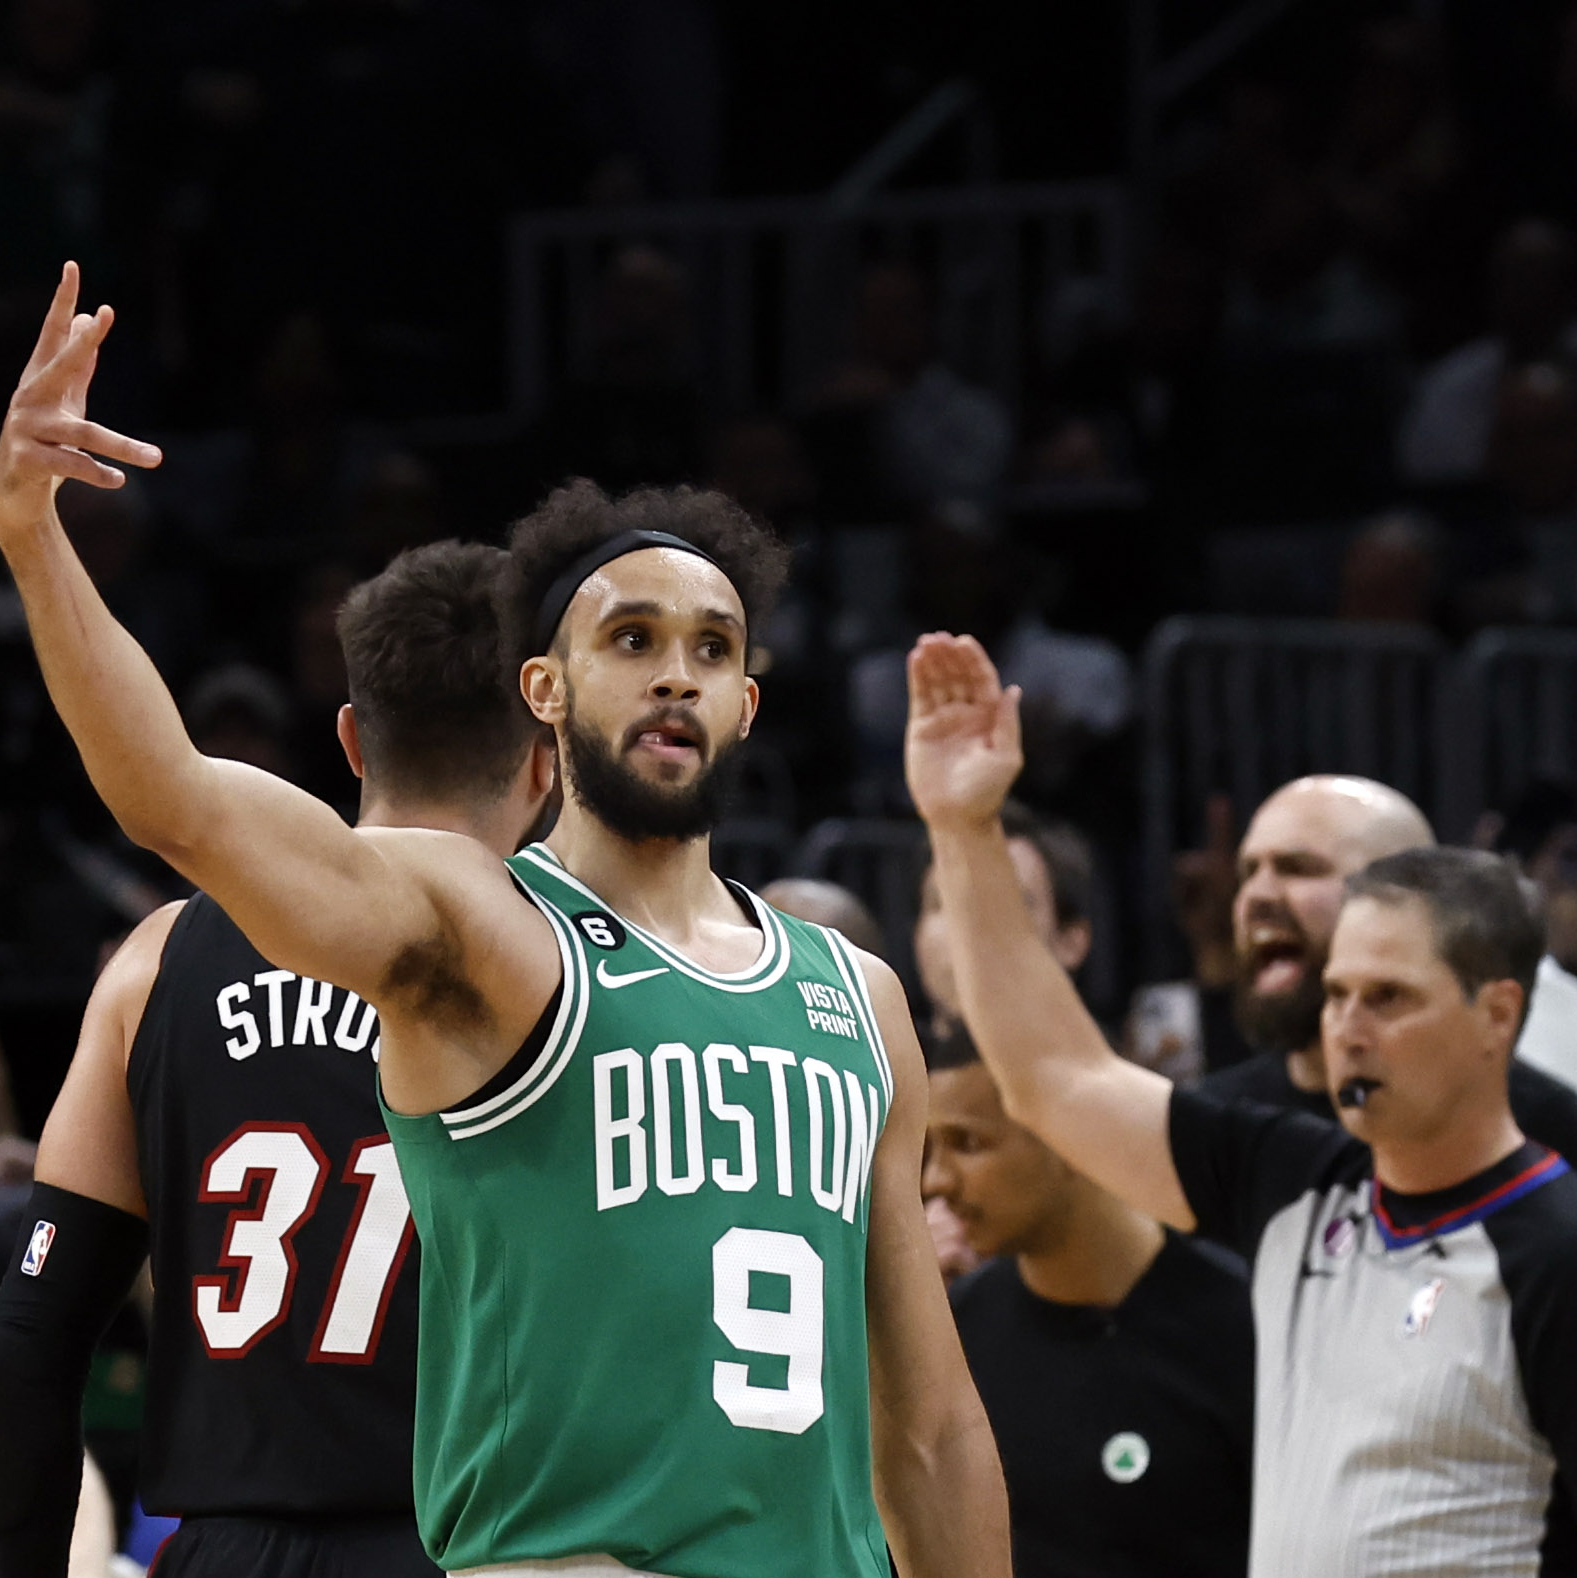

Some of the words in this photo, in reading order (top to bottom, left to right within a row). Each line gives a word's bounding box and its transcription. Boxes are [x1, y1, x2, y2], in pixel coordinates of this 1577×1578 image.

[581, 917, 616, 946] 6
[216, 969, 380, 1062] STRU
[796, 981, 855, 1019] VISTA
[806, 1008, 859, 1041] PRINT
[593, 1042, 879, 1234] BOSTON
[191, 1120, 417, 1365] 31
[712, 1226, 825, 1436] 9
